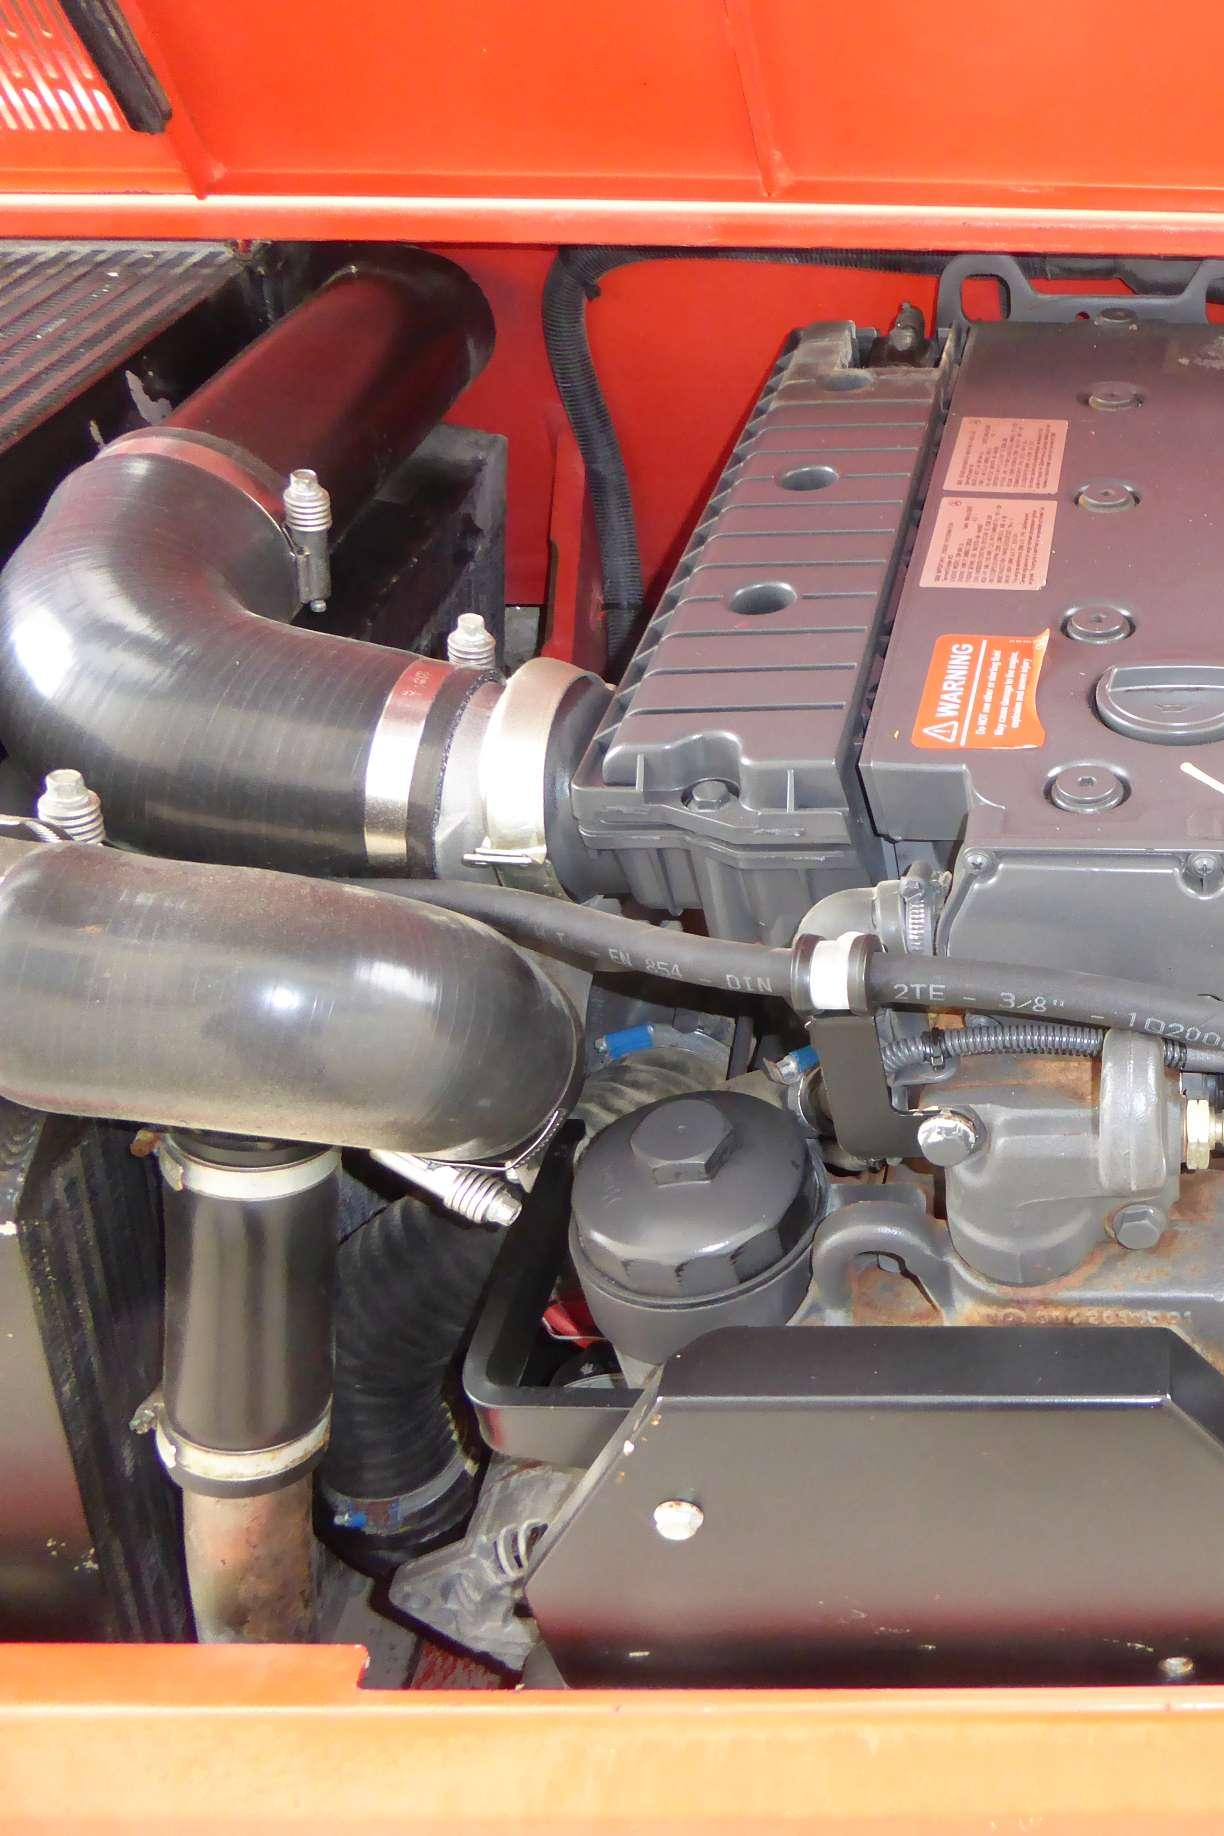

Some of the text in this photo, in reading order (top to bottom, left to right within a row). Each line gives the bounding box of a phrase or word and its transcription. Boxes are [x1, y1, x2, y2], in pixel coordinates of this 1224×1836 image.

[936, 643, 975, 717] WARNING
[608, 949, 632, 967] EN
[644, 958, 683, 979] 854
[725, 973, 773, 993] DIN
[893, 984, 946, 1001] 2TE
